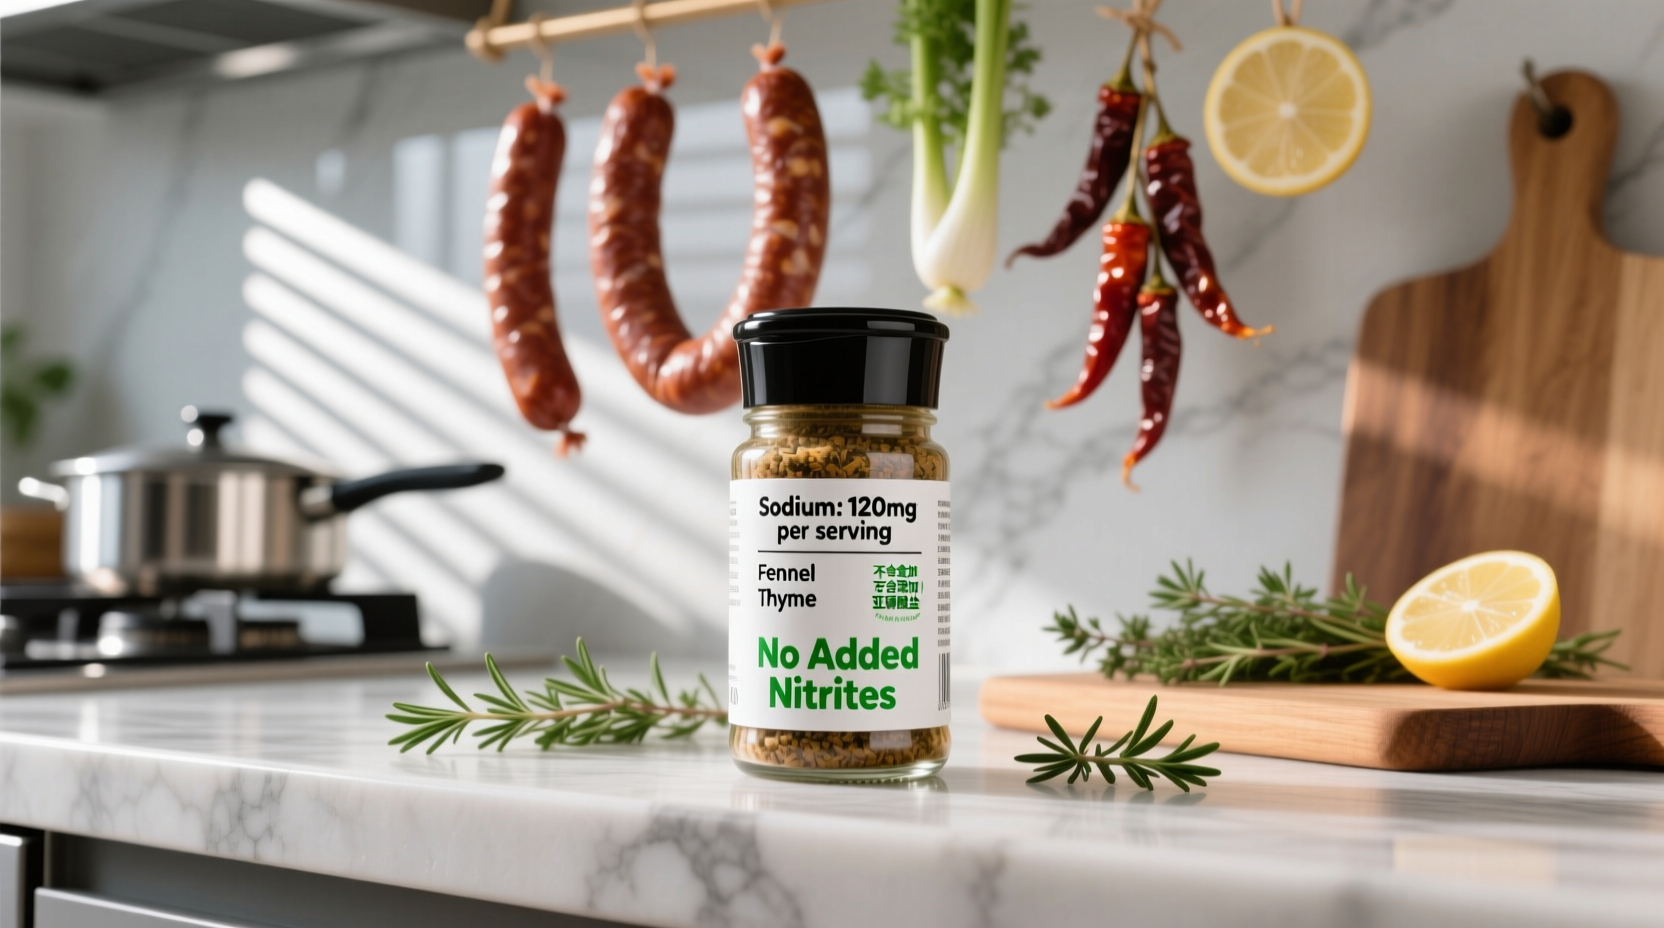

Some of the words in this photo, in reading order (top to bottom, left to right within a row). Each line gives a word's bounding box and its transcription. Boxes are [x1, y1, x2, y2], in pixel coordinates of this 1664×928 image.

[758, 495, 842, 517] Sodium:
[848, 496, 917, 523] 120mg
[777, 524, 809, 545] per
[815, 520, 892, 545] serving
[758, 563, 816, 582] Fennel
[758, 588, 817, 612] Thyme
[758, 637, 800, 669] No
[807, 637, 919, 670] Added
[769, 675, 897, 710] Nitrites
